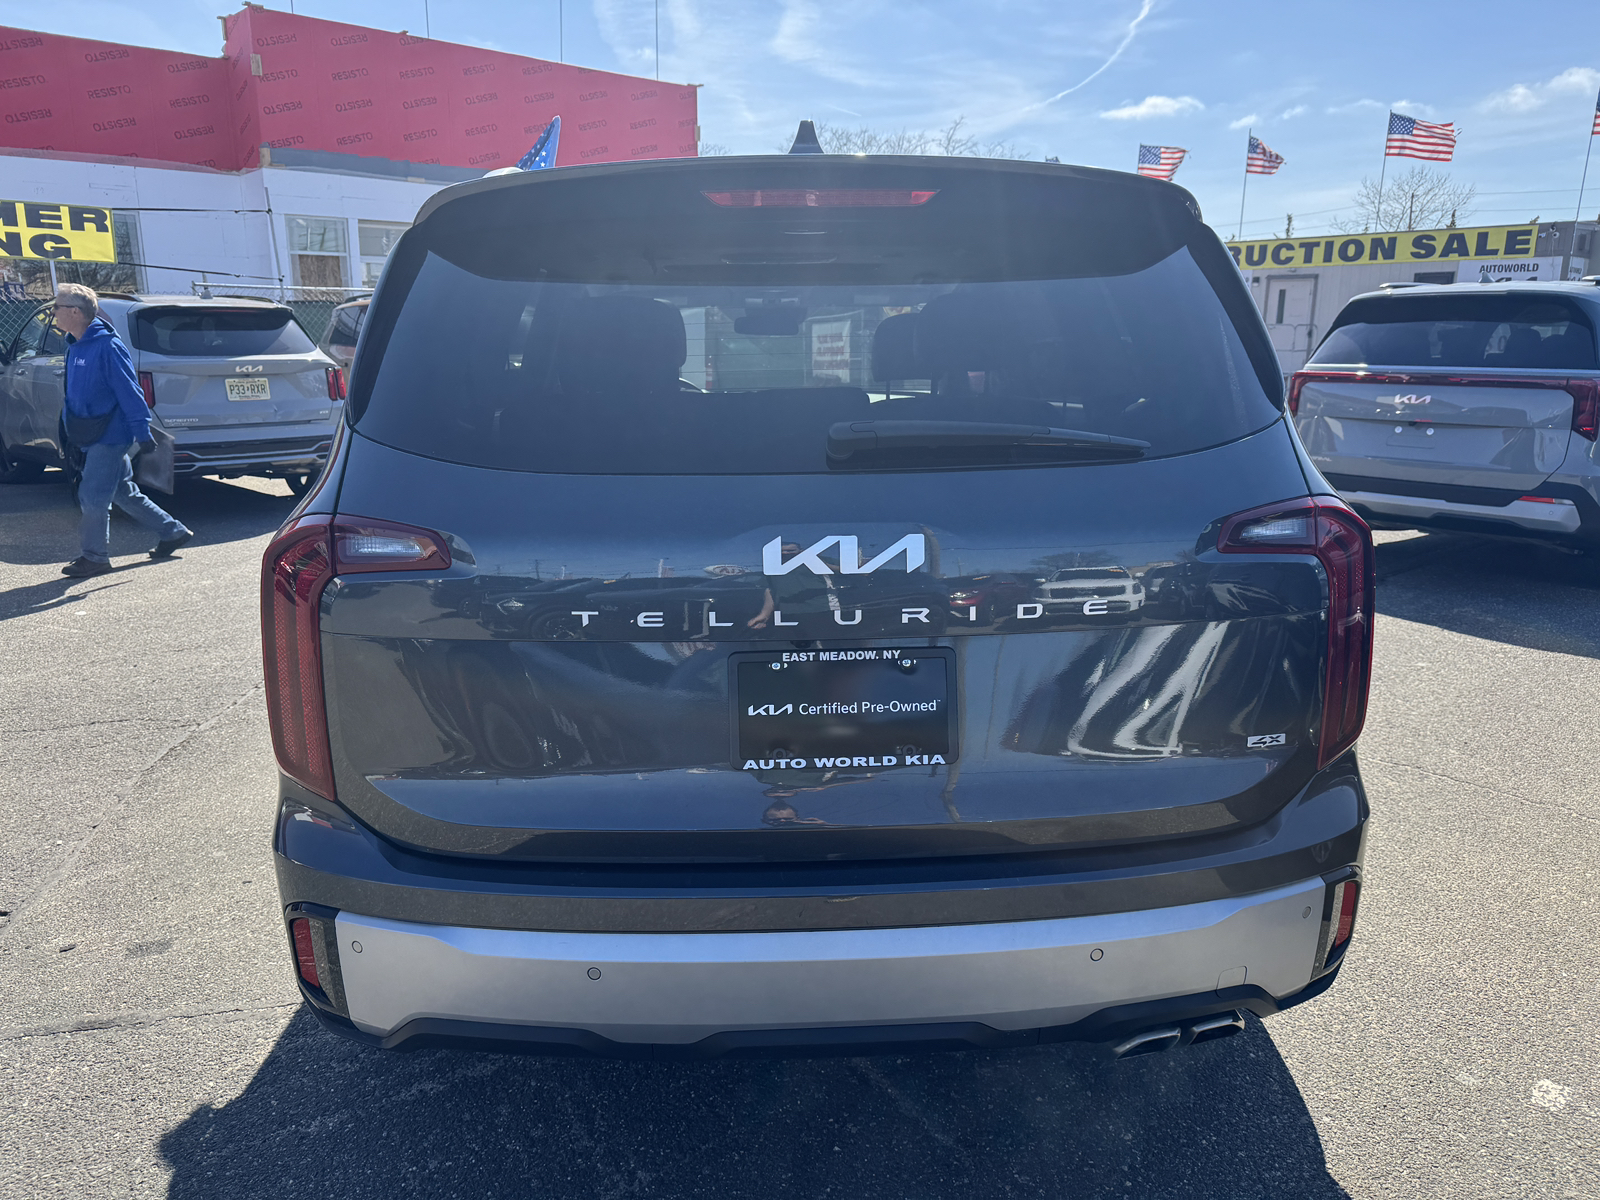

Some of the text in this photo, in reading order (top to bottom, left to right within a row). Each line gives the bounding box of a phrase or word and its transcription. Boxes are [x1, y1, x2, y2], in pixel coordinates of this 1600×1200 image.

[257, 33, 297, 47] RESISTO
[331, 33, 368, 47] RESISTO
[85, 49, 130, 63] RESISTO
[167, 60, 208, 74] RESISTO
[399, 66, 435, 80] RESISTO
[462, 63, 496, 77] RESISTO
[331, 67, 369, 82] RESISTO
[0, 74, 46, 90] RESISTO
[87, 84, 132, 100] RESISTO
[465, 92, 498, 106] RESISTO
[169, 94, 210, 109] RESISTO
[263, 100, 303, 115] RESISTO
[335, 98, 373, 113] RESISTO
[402, 95, 437, 110] RESISTO
[5, 107, 52, 124] RESISTO
[93, 117, 137, 132] RESISTO
[465, 123, 498, 137] RESISTO
[174, 125, 215, 140] RESISTO
[336, 131, 373, 147] RESISTO
[403, 128, 438, 142] RESISTO
[469, 151, 501, 165] RESISTO
[1410, 228, 1533, 259] SALE
[1479, 262, 1539, 274] AUTOWORLD
[235, 364, 263, 373] KIA
[1394, 393, 1432, 404] KIA
[762, 533, 925, 576] KIA
[571, 599, 1108, 628] TELLURIDE
[782, 652, 815, 662] EAST
[883, 649, 901, 660] NY
[747, 703, 793, 716] KIA
[799, 702, 858, 715] Certified
[742, 754, 946, 770] AUTO WORLD KIA
